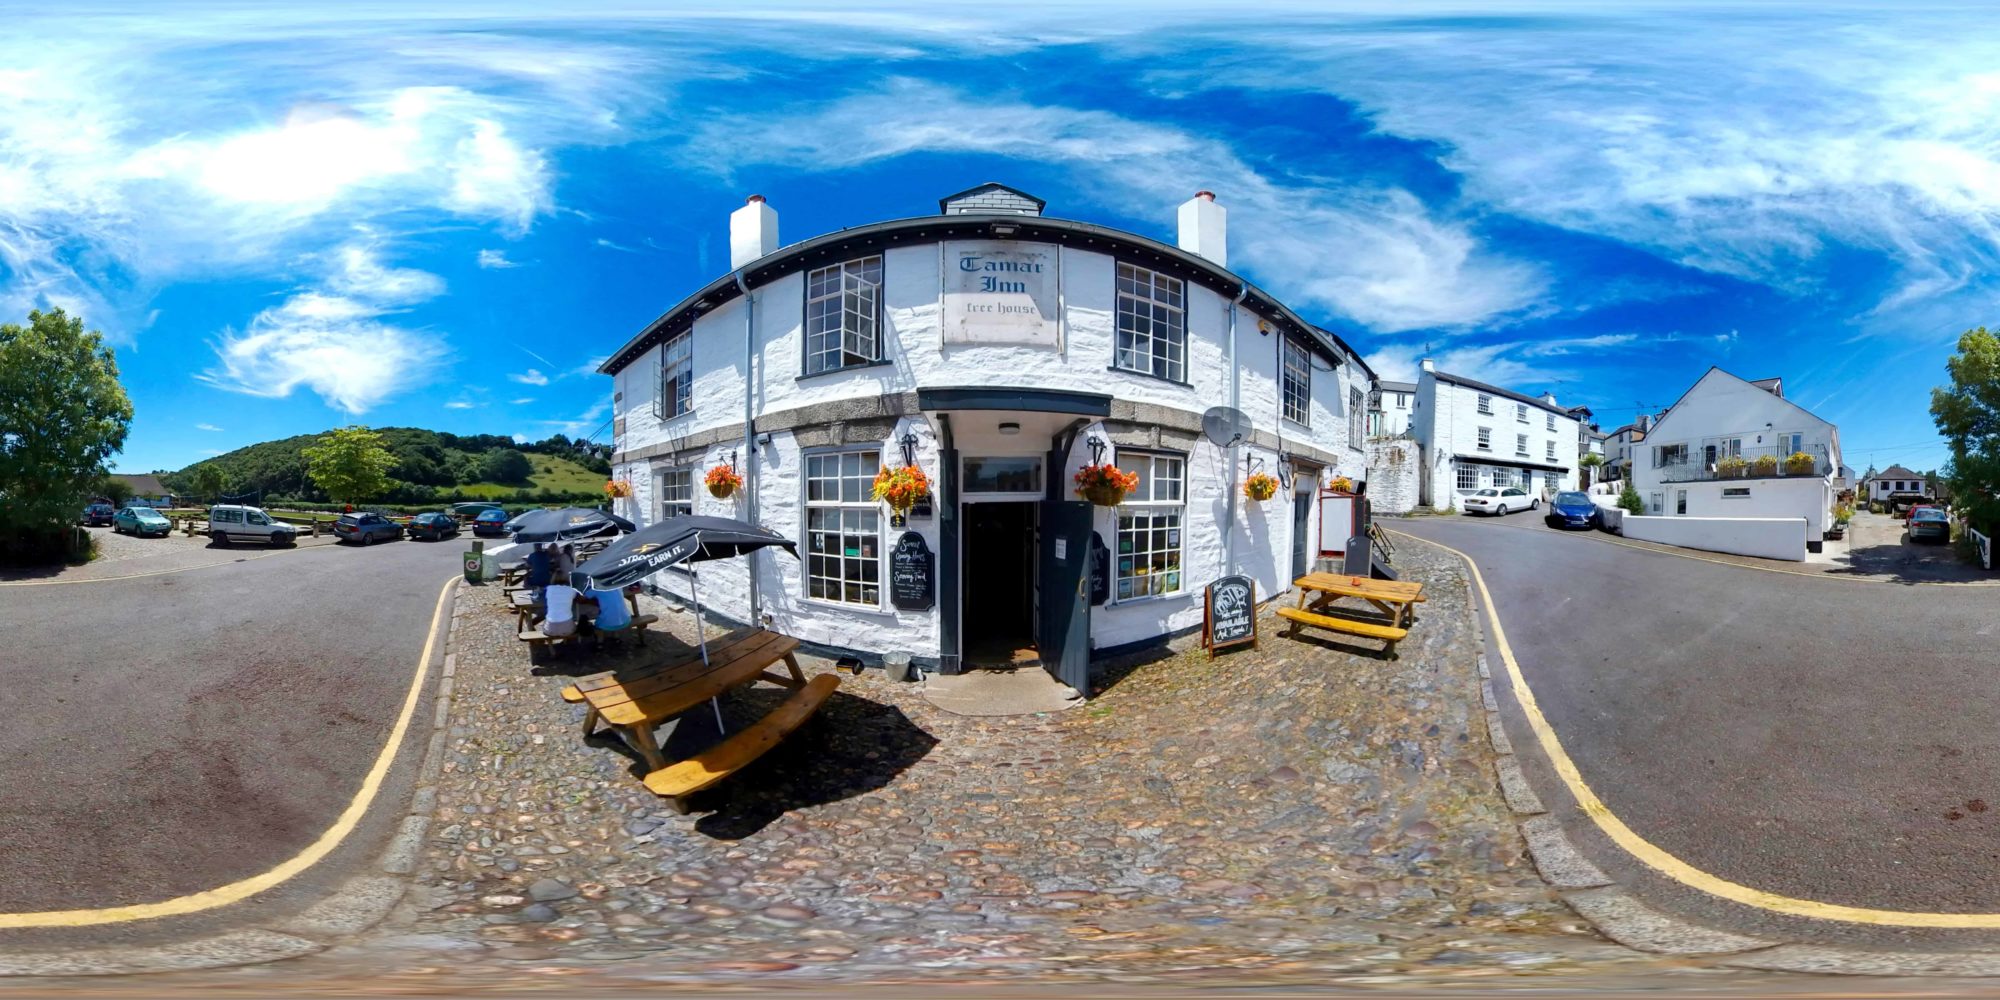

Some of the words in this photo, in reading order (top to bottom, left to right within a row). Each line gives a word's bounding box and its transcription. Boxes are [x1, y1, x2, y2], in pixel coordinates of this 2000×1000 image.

[960, 256, 1043, 273] Tamar
[980, 276, 1026, 293] Inn
[967, 303, 993, 313] free
[997, 302, 1036, 314] house
[648, 550, 672, 567] EARN
[672, 545, 685, 555] IT.
[1215, 616, 1249, 630] AVAILABLE
